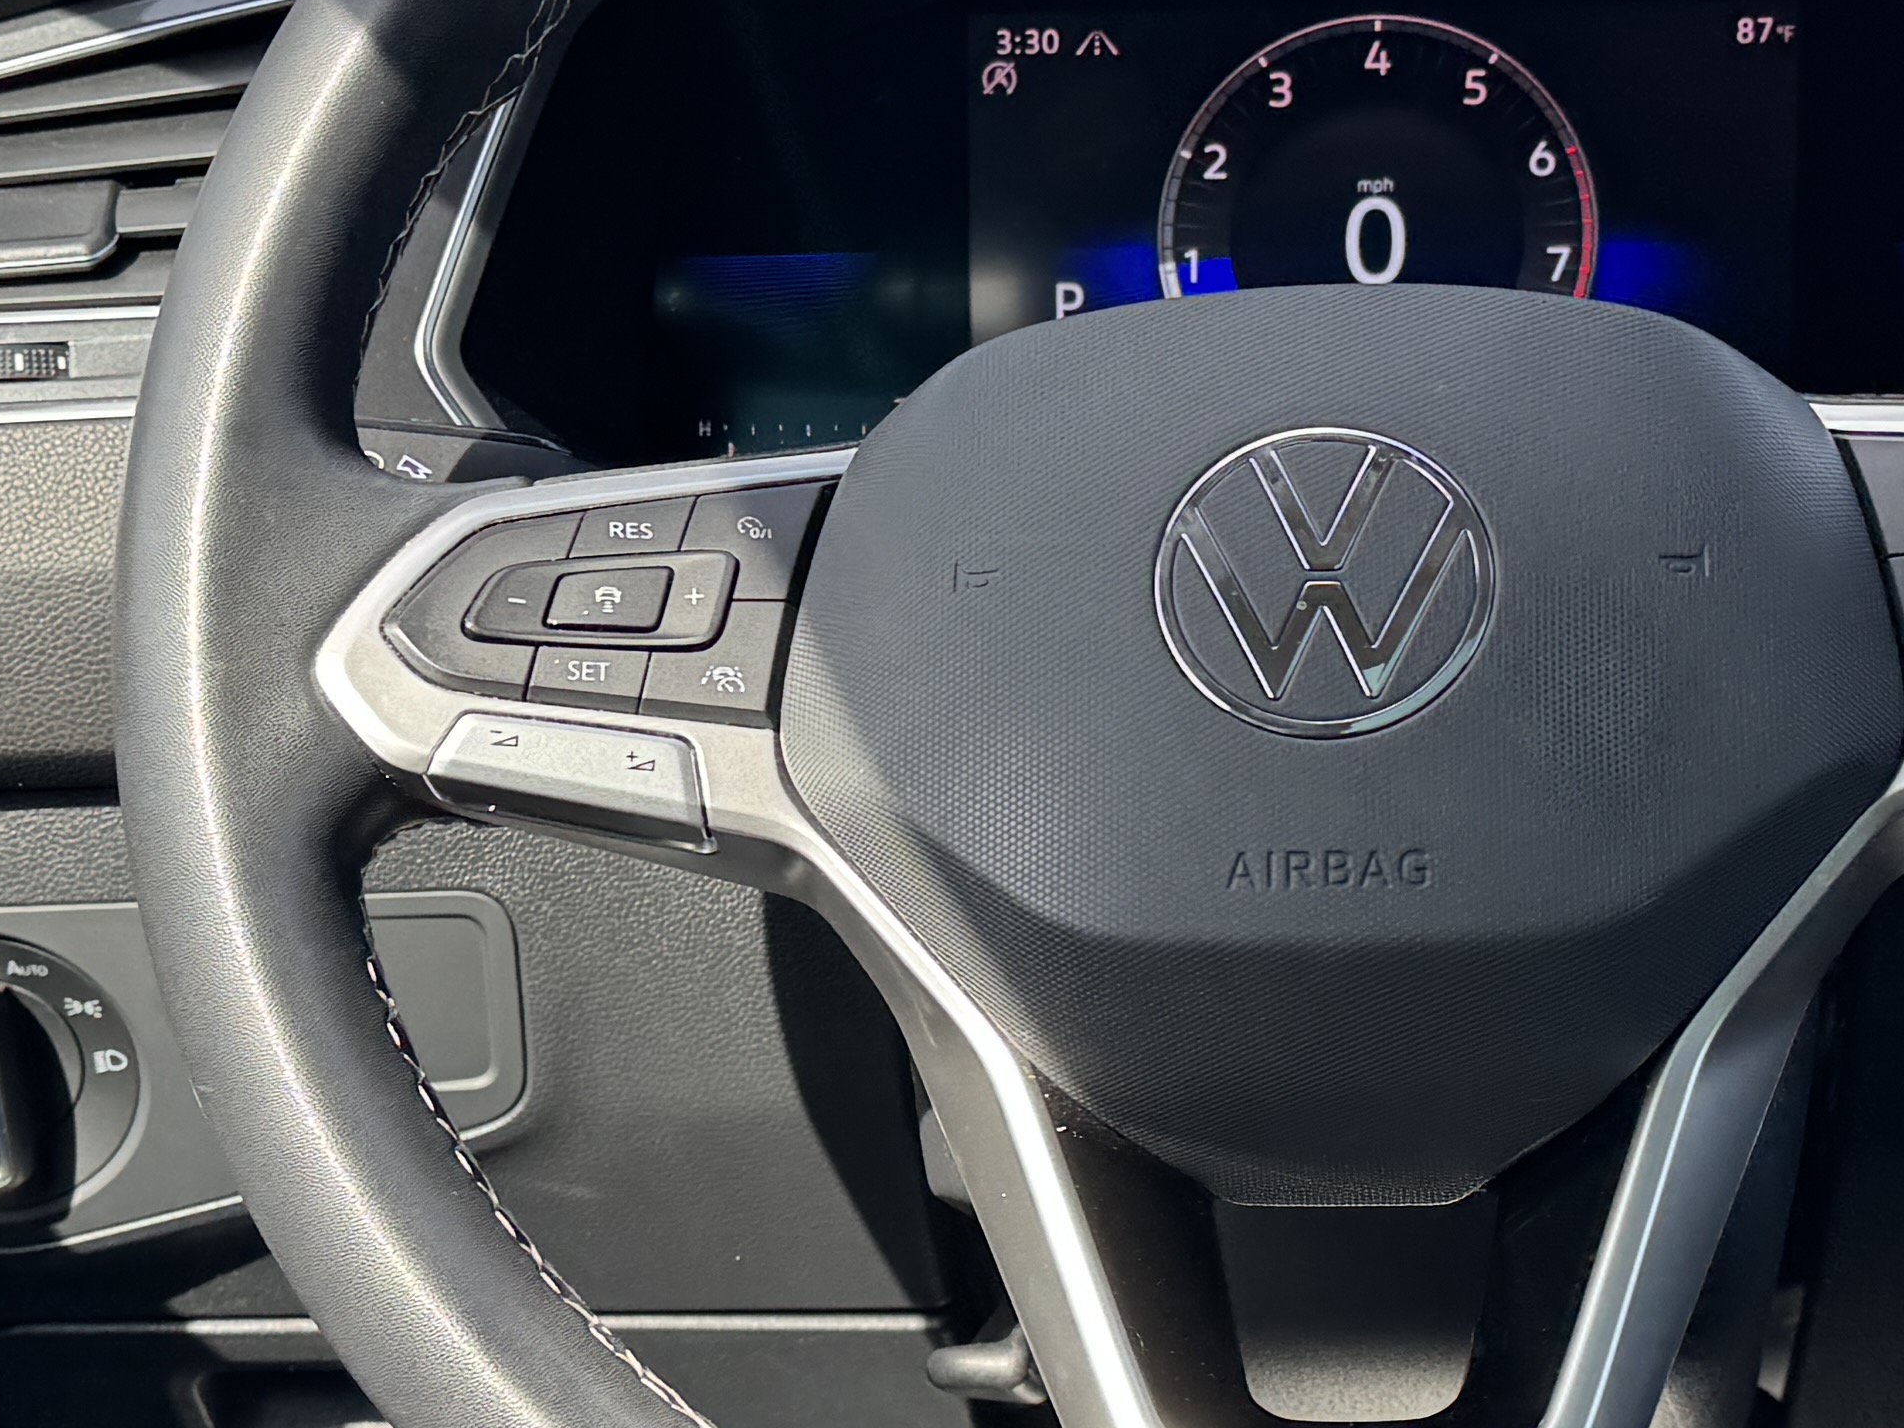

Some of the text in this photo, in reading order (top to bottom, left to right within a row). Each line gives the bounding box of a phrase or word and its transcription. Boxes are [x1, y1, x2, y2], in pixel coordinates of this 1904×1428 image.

[994, 26, 1060, 58] 3:30
[1735, 15, 1796, 47] 87°F
[1363, 41, 1393, 78] 4
[1265, 71, 1294, 109] 3
[1461, 68, 1490, 107] 5
[1201, 142, 1229, 181] 2
[1527, 139, 1557, 178] 6
[1356, 176, 1395, 201] mph
[1342, 194, 1407, 288] 0
[1183, 249, 1200, 284] 1
[1545, 245, 1572, 283] 7
[1053, 282, 1086, 321] P
[608, 520, 655, 541] RES
[566, 660, 612, 683] SET
[1226, 846, 1436, 893] AIRBAG
